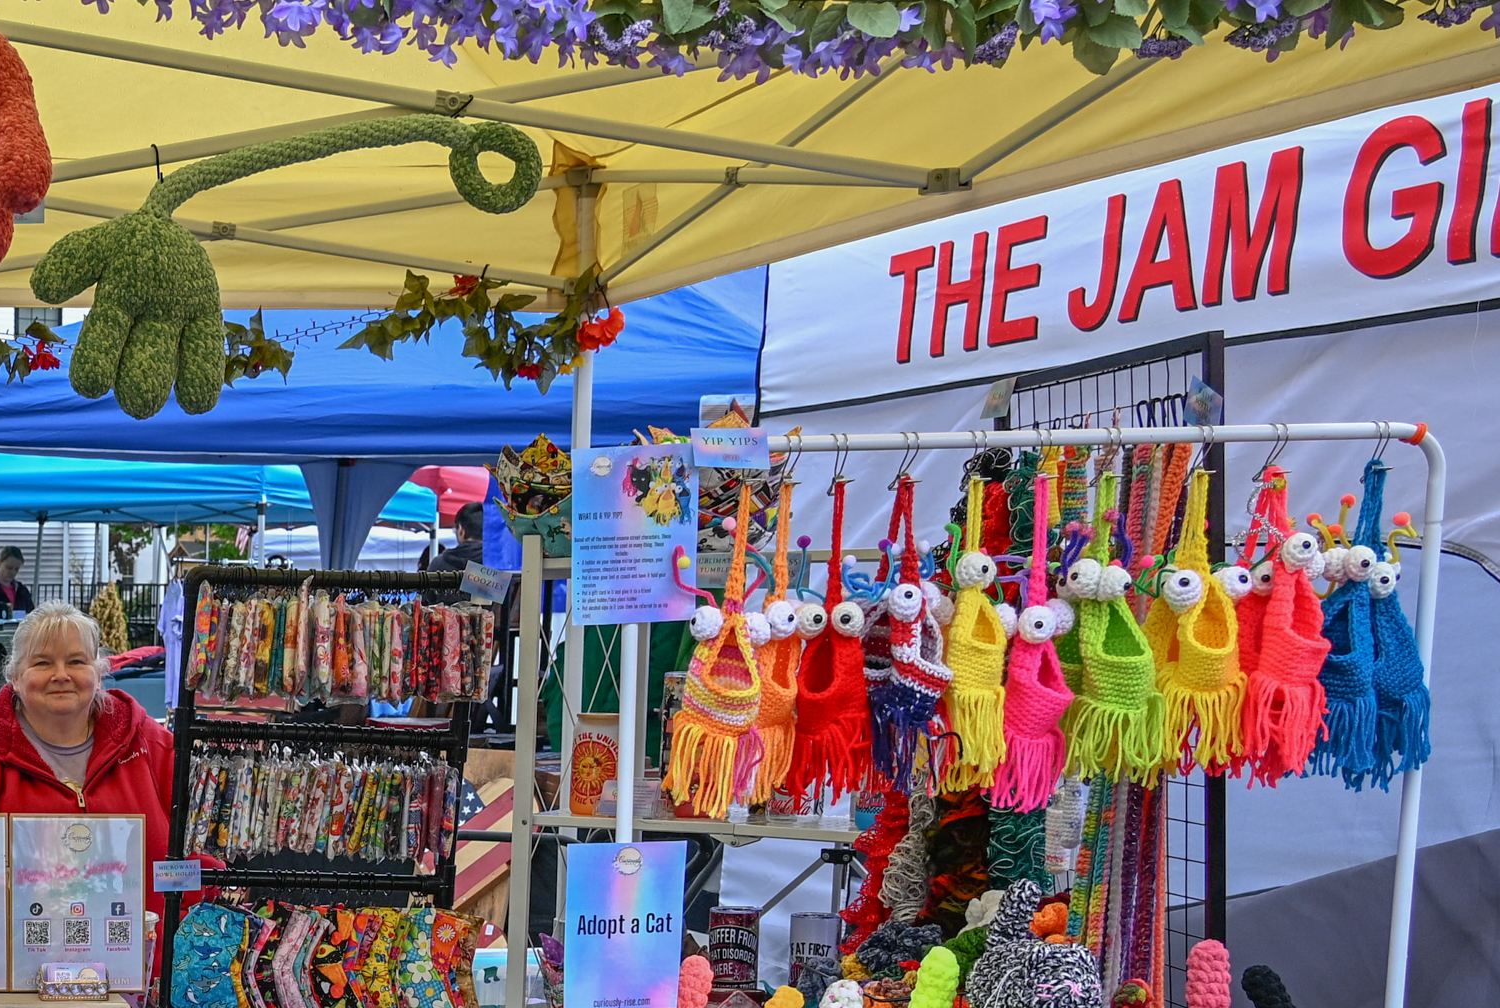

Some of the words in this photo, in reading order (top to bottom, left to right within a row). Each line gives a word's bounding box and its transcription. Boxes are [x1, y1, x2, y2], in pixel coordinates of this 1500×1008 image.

[889, 215, 1049, 363] THE
[1067, 145, 1305, 332] JAM
[1342, 97, 1500, 279] GI
[701, 436, 724, 445] YIP
[730, 436, 758, 446] YIPS
[578, 512, 591, 520] WHAT
[480, 567, 498, 577] CUP
[577, 914, 625, 939] Adopt
[631, 917, 640, 933] a
[646, 912, 672, 933] Cat
[796, 943, 805, 956] AT
[808, 943, 831, 957] FIRST
[593, 998, 650, 1008] curiously-rise.com
